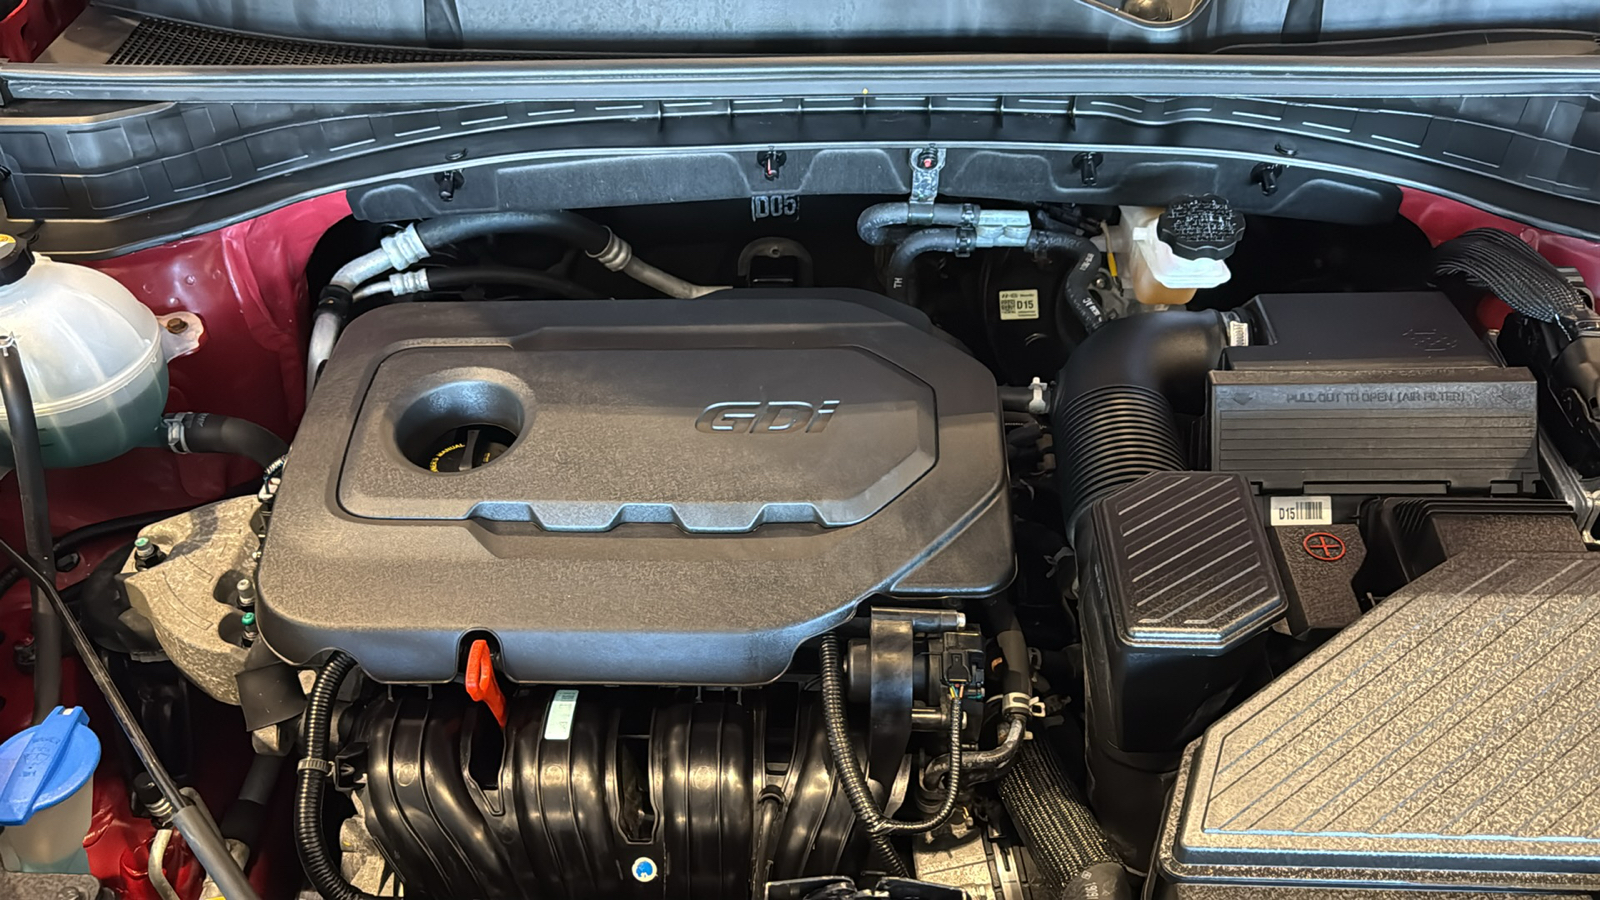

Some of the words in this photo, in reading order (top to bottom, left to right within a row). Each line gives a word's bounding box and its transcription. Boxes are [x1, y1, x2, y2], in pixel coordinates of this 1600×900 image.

[1016, 300, 1034, 310] D15
[1344, 392, 1360, 403] TO
[1362, 392, 1393, 403] OPEN
[436, 443, 465, 457] MANUAL
[1279, 507, 1296, 520] D15
